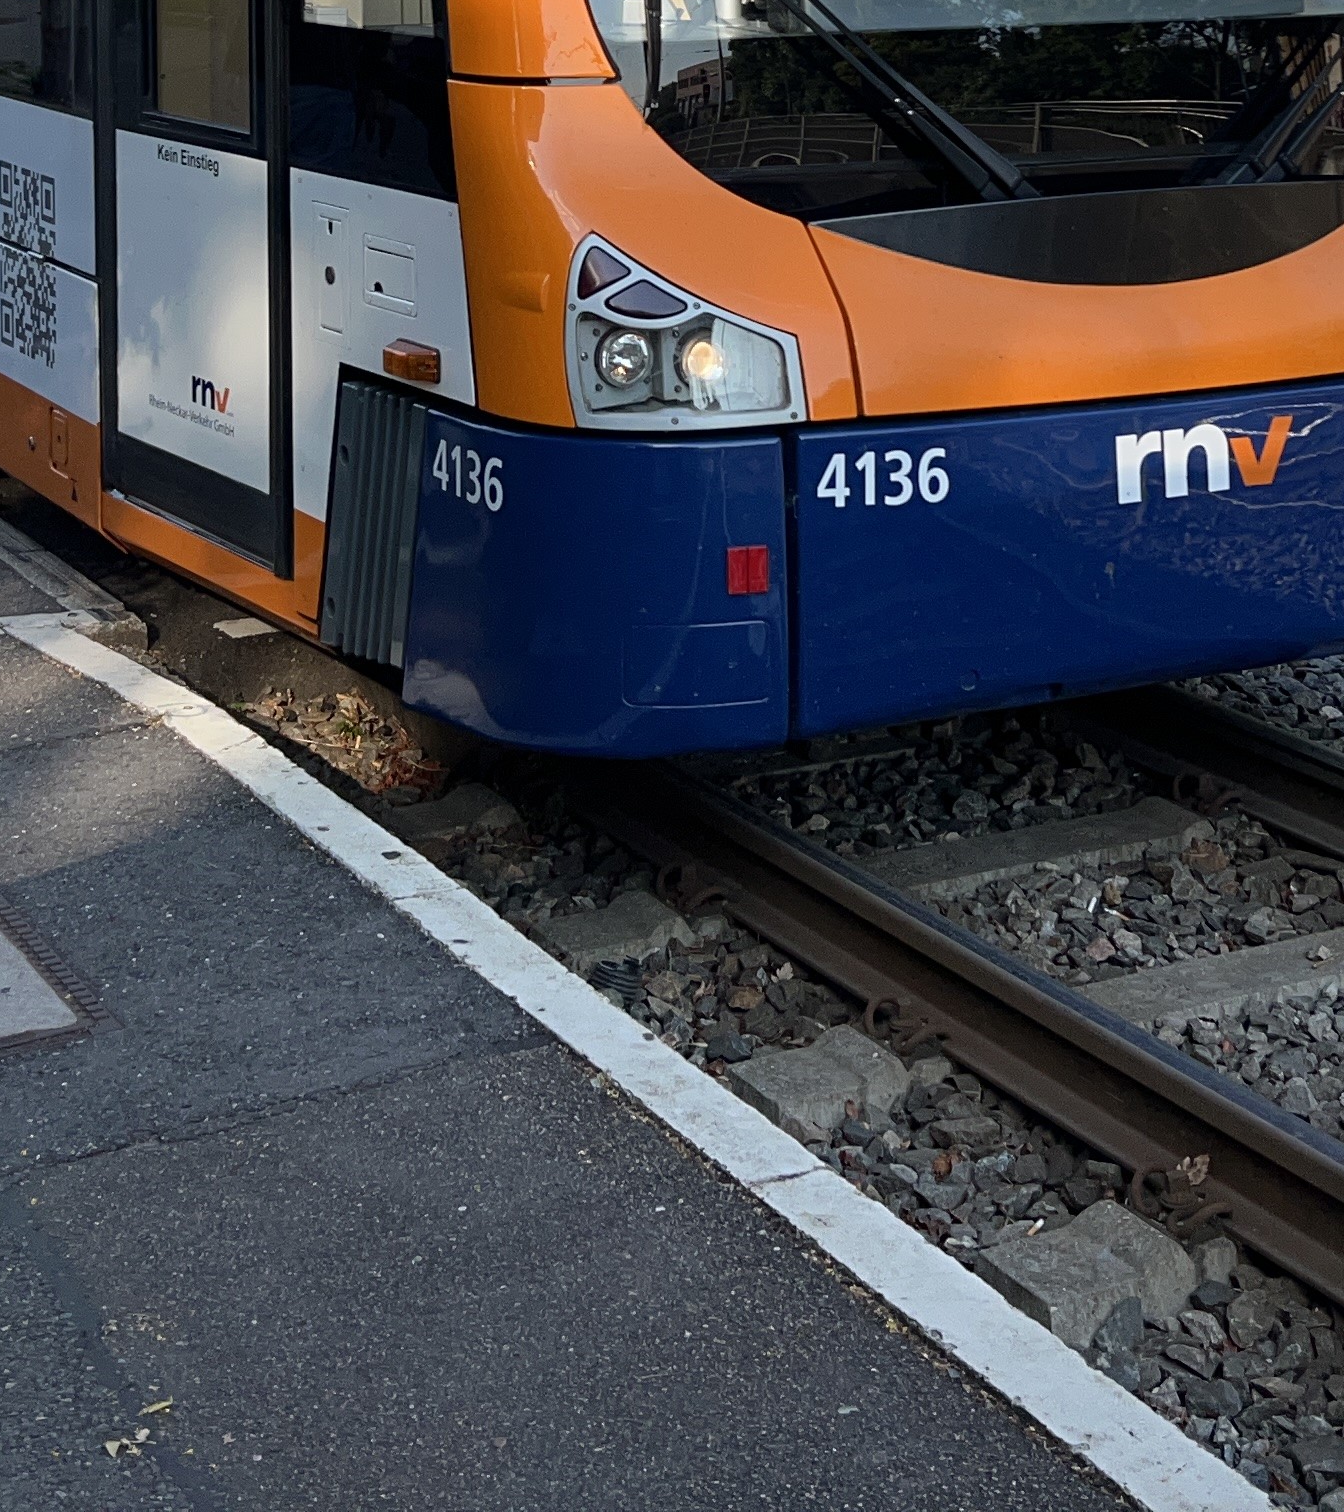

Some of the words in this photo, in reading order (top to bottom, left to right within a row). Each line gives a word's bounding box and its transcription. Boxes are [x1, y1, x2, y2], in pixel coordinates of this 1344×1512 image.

[157, 144, 178, 163] Kein
[181, 149, 219, 177] Einstieg
[192, 375, 230, 414] rnv
[214, 419, 235, 437] GmbH
[432, 439, 504, 512] 4136
[817, 447, 950, 508] 4136
[1115, 415, 1293, 505] rnv
